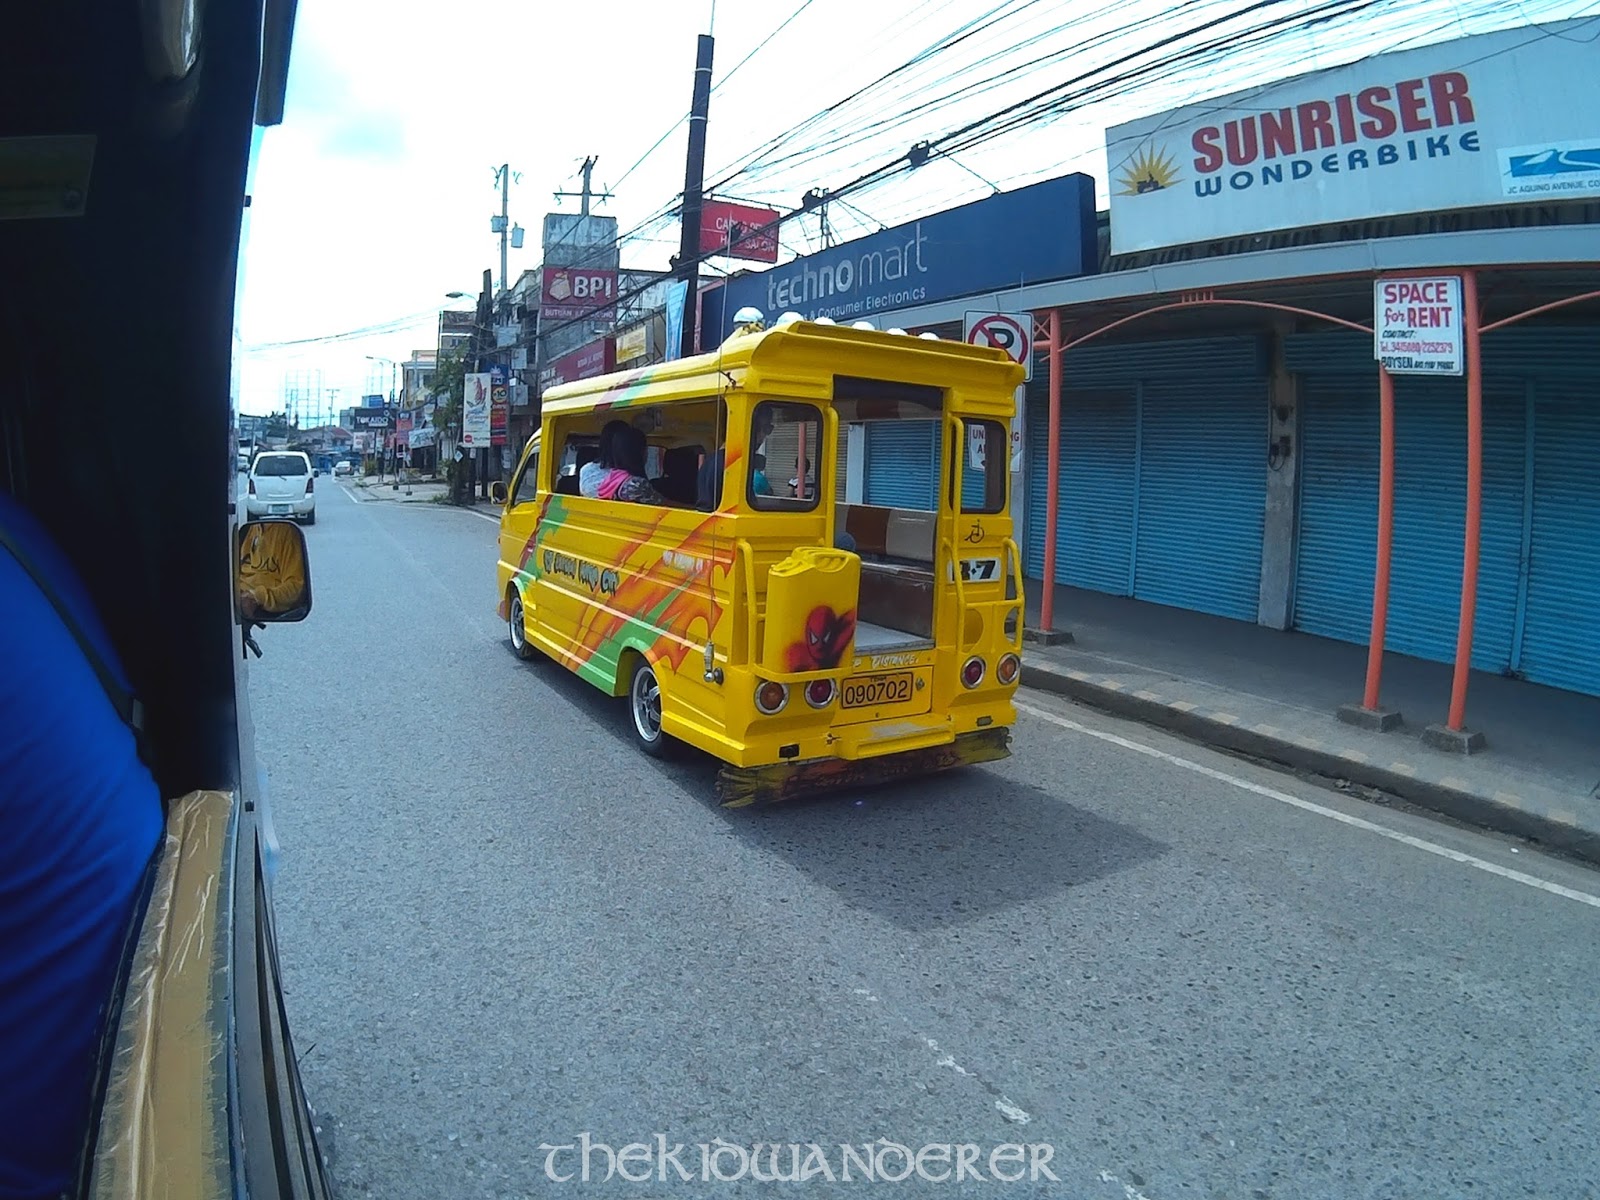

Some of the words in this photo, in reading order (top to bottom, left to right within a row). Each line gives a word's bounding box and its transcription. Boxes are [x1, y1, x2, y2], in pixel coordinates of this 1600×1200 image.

[1192, 71, 1476, 174] SUNRISER
[1194, 130, 1481, 198] WONDERBIKE
[767, 258, 854, 312] techno
[858, 222, 928, 286] mart
[574, 275, 612, 299] BPI
[1384, 282, 1449, 305] SPACE
[817, 302, 865, 319] Consumer
[866, 286, 926, 310] Electronics
[1384, 307, 1406, 327] for
[1407, 306, 1452, 328] RENT
[845, 680, 908, 705] 090702
